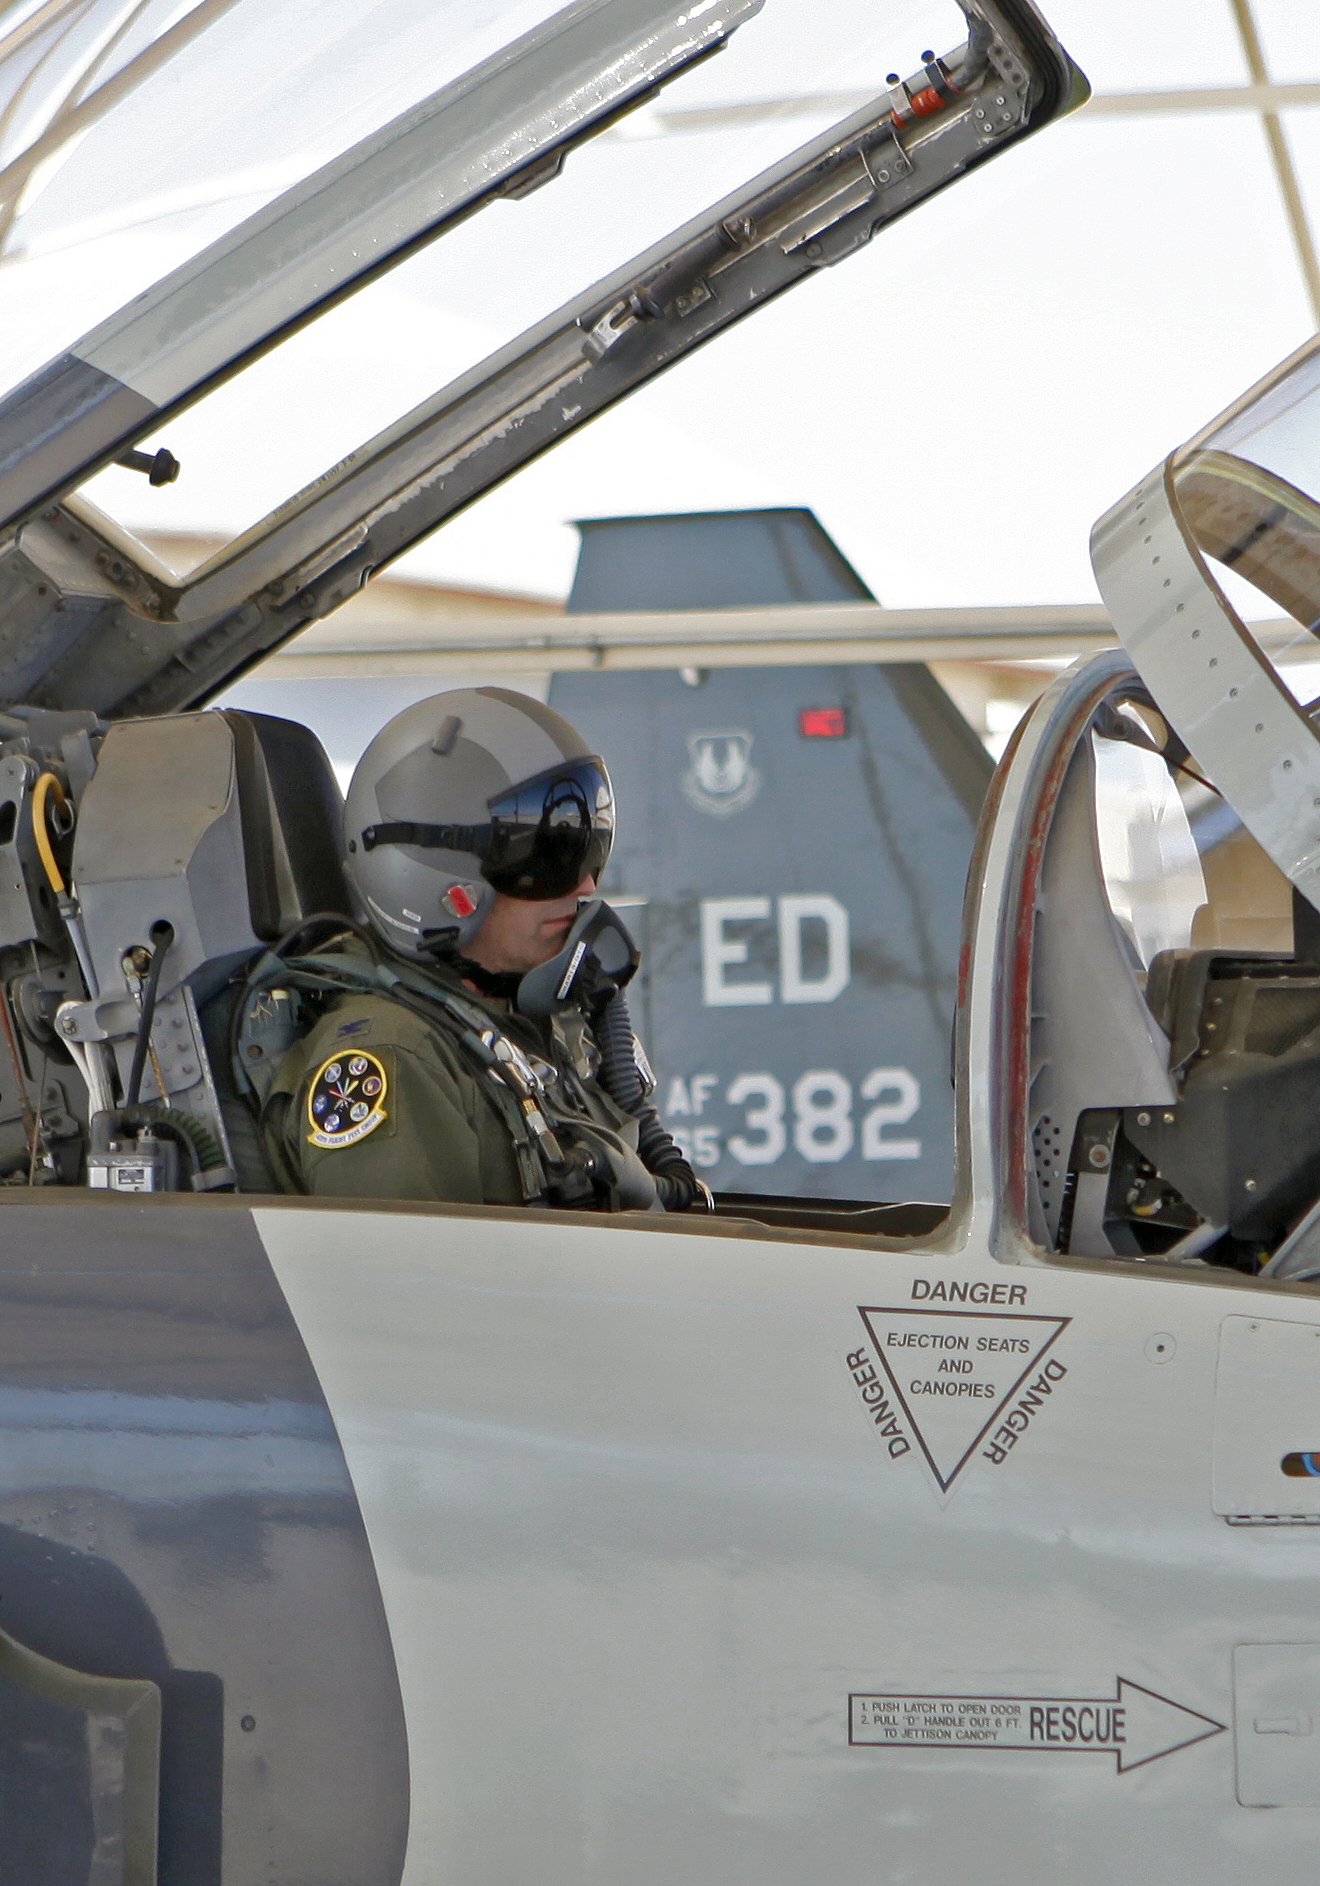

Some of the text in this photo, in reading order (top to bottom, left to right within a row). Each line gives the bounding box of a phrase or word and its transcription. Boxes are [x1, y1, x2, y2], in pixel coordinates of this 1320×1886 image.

[702, 893, 850, 1007] ED
[666, 1074, 719, 1117] AF
[727, 1067, 922, 1165] 382
[911, 1279, 1027, 1306] DANGER
[887, 1333, 1030, 1353] EJECTION SEATS
[938, 1359, 973, 1374] AND
[910, 1380, 995, 1398] CANOPIES
[846, 1348, 911, 1460] DANGER
[982, 1358, 1068, 1465] DANGER
[872, 1702, 900, 1713] PUSH
[904, 1703, 936, 1714] LATCH
[941, 1703, 954, 1714] TO
[959, 1704, 987, 1715] OPEN
[991, 1704, 1021, 1716] DOOR
[874, 1715, 899, 1726] PULL
[924, 1716, 965, 1728] HANDLE
[970, 1717, 991, 1728] OUT
[885, 1728, 998, 1741] TO JETTISON CANOPY
[1030, 1706, 1126, 1744] RESCUE
